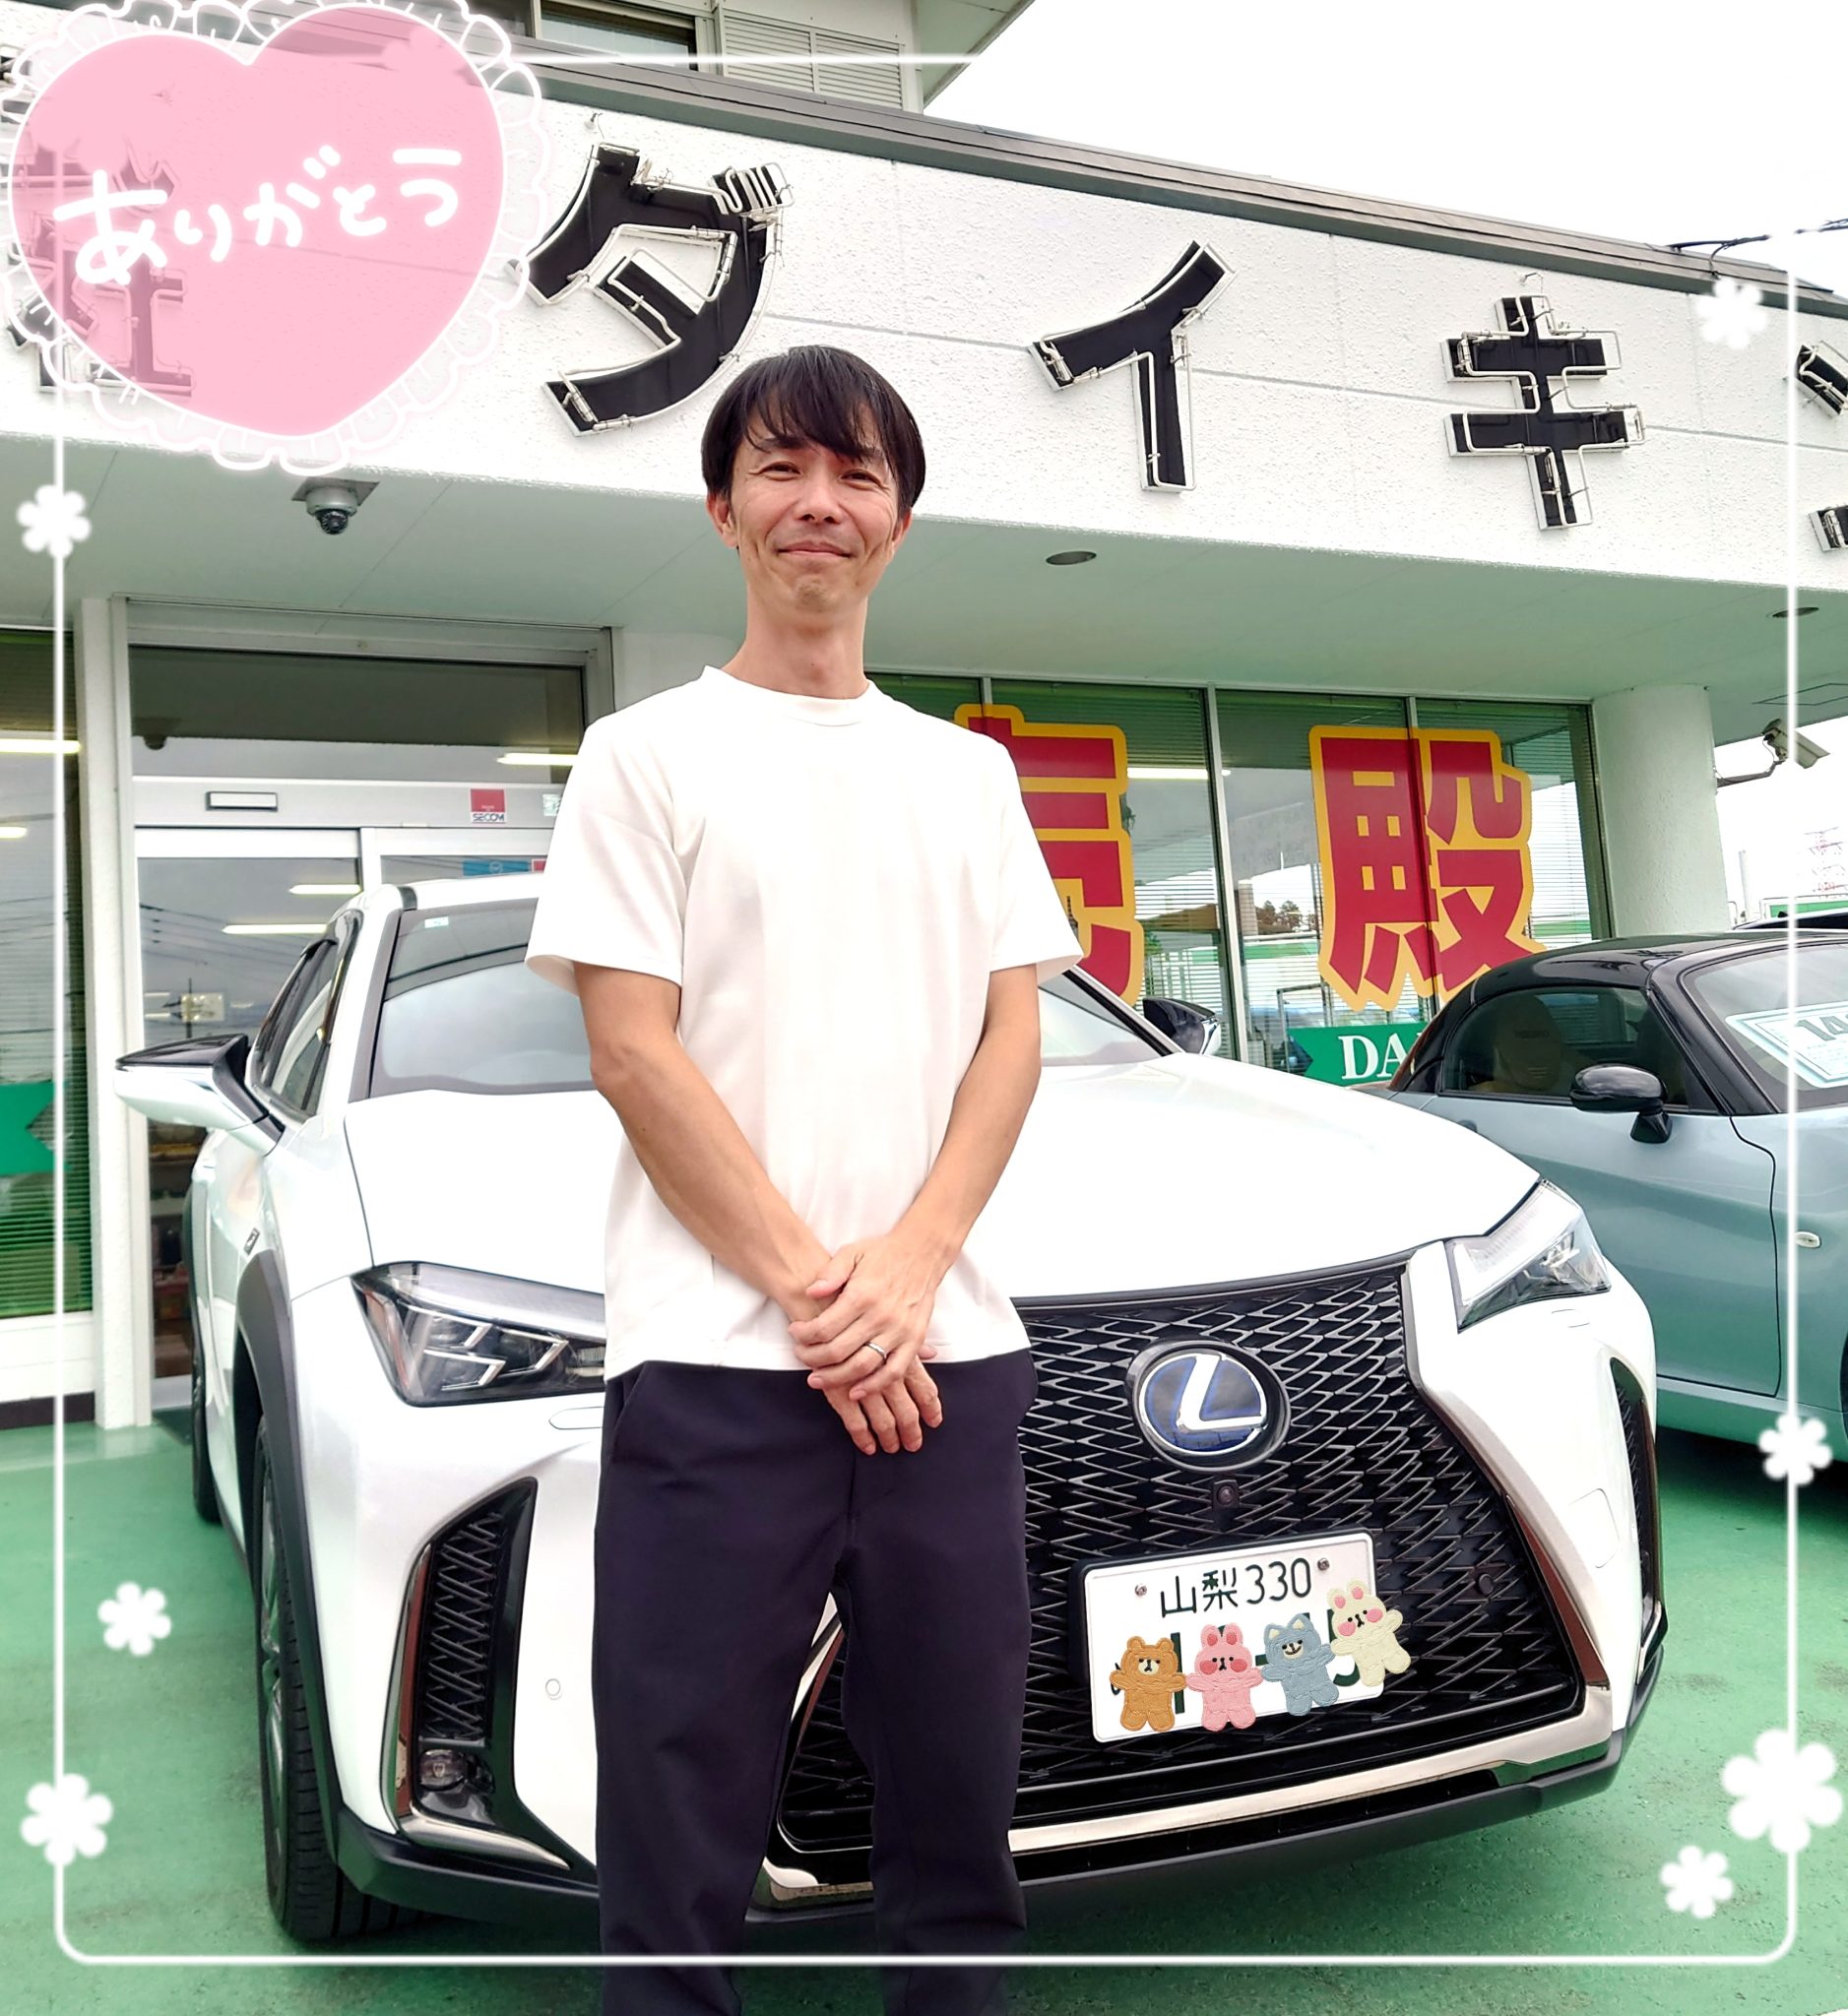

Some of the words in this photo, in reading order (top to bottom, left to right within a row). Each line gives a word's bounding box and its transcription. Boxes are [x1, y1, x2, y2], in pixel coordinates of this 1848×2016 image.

[506, 141, 1848, 553] ダイキ
[473, 812, 505, 822] SECOM
[1338, 1032, 1423, 1080] DA
[1160, 1557, 1312, 1617] 山梨330
